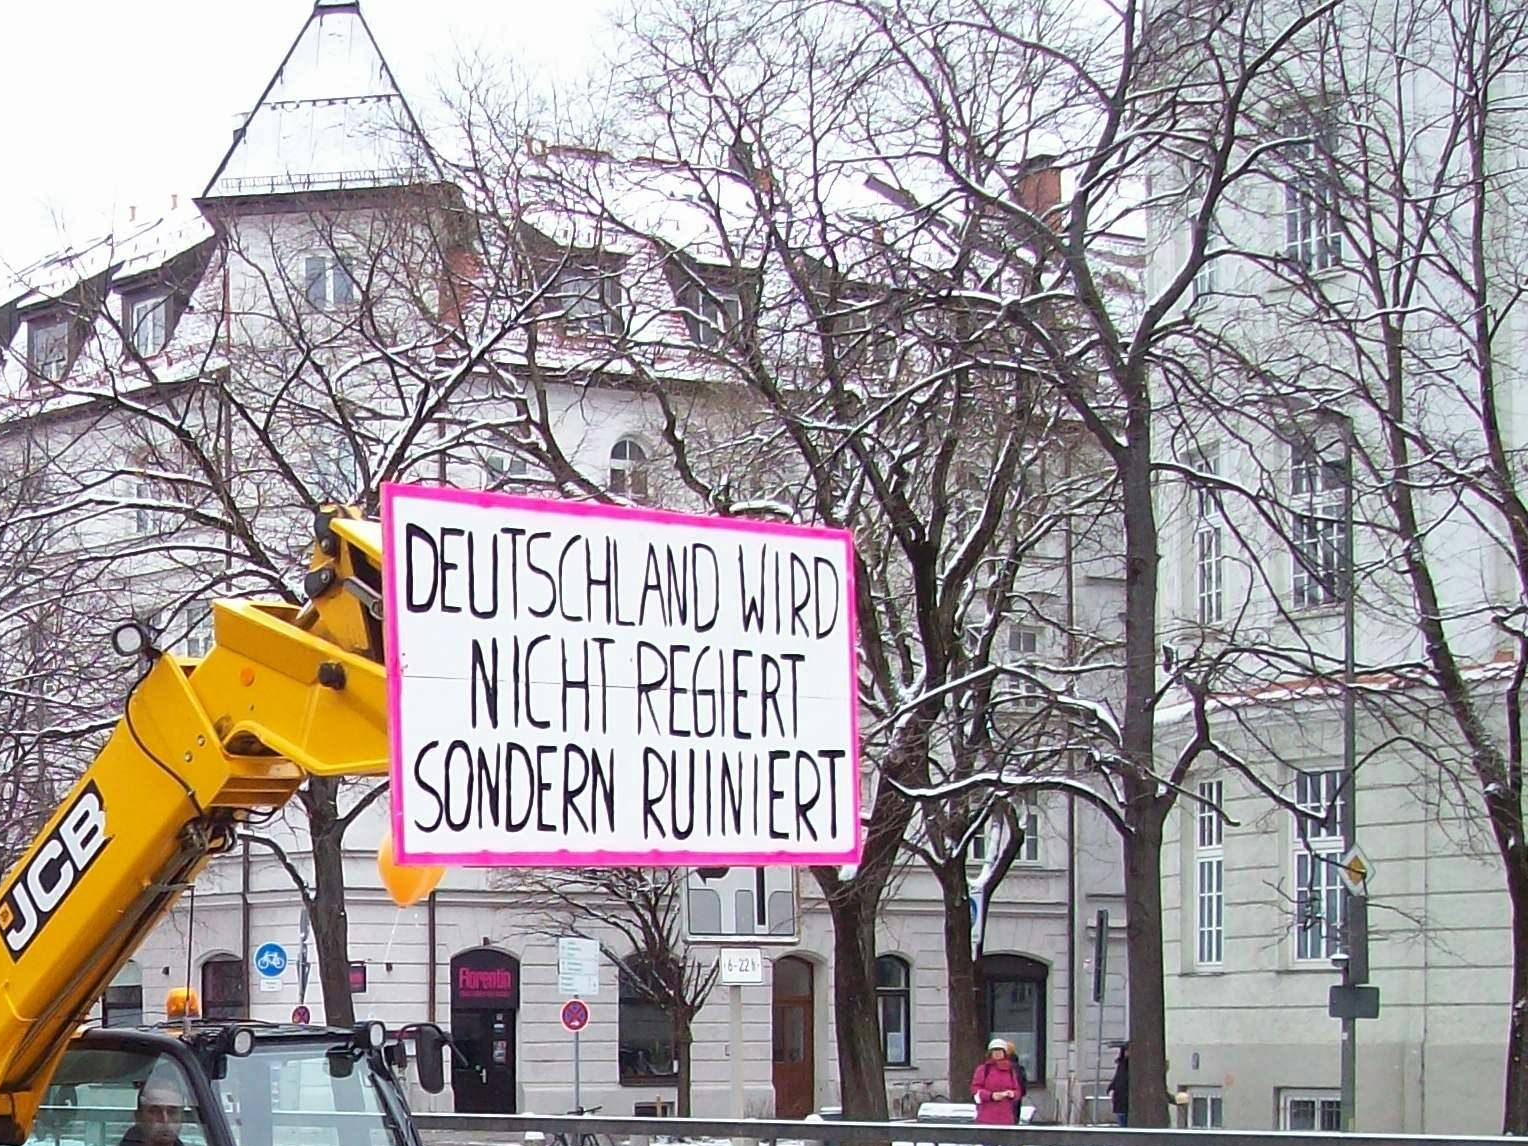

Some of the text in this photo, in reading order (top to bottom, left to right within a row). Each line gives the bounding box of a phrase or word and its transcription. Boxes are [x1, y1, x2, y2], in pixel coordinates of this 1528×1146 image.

[405, 522, 839, 639] DEUTSCHLAND WIRD
[471, 634, 805, 740] NICHT REGIERT
[414, 740, 846, 842] SONDERN RUINIERT
[6, 793, 106, 951] JCB
